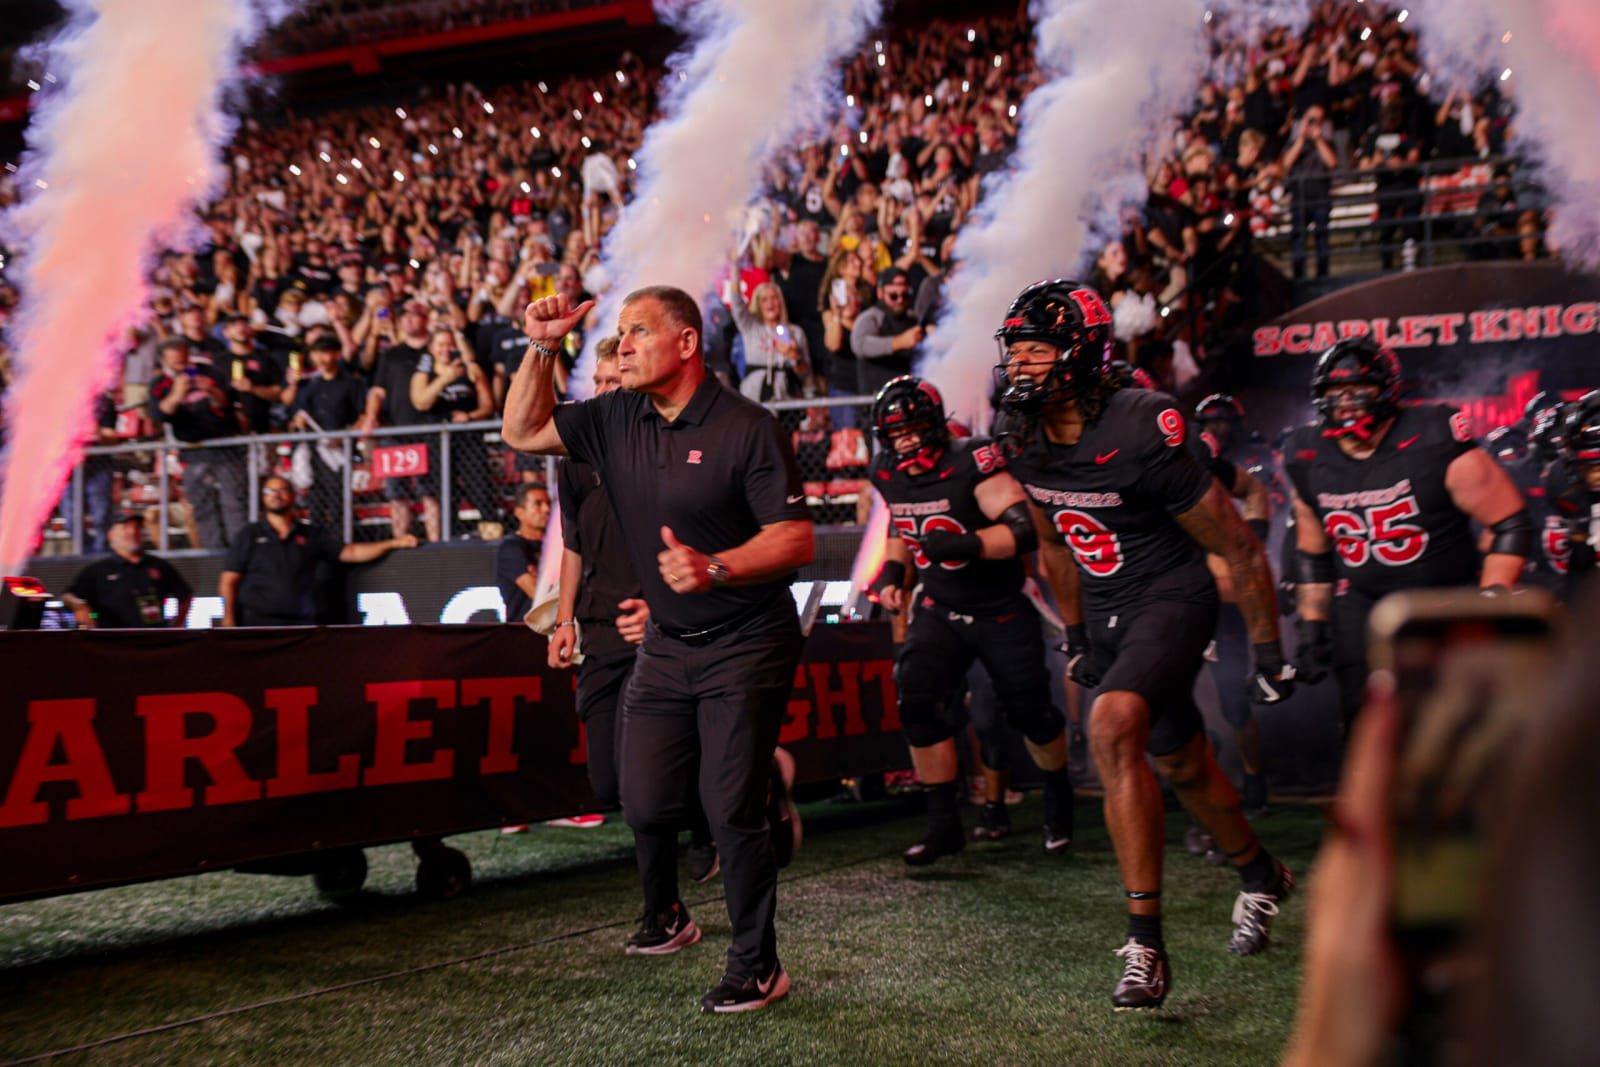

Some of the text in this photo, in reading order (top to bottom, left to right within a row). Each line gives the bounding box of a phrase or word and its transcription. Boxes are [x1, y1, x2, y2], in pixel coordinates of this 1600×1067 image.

[1468, 302, 1600, 344] KNIG
[1157, 408, 1186, 447] 9
[381, 448, 419, 475] 129
[1053, 509, 1124, 577] 9
[1322, 495, 1430, 568] 65
[0, 676, 543, 828] ARLET
